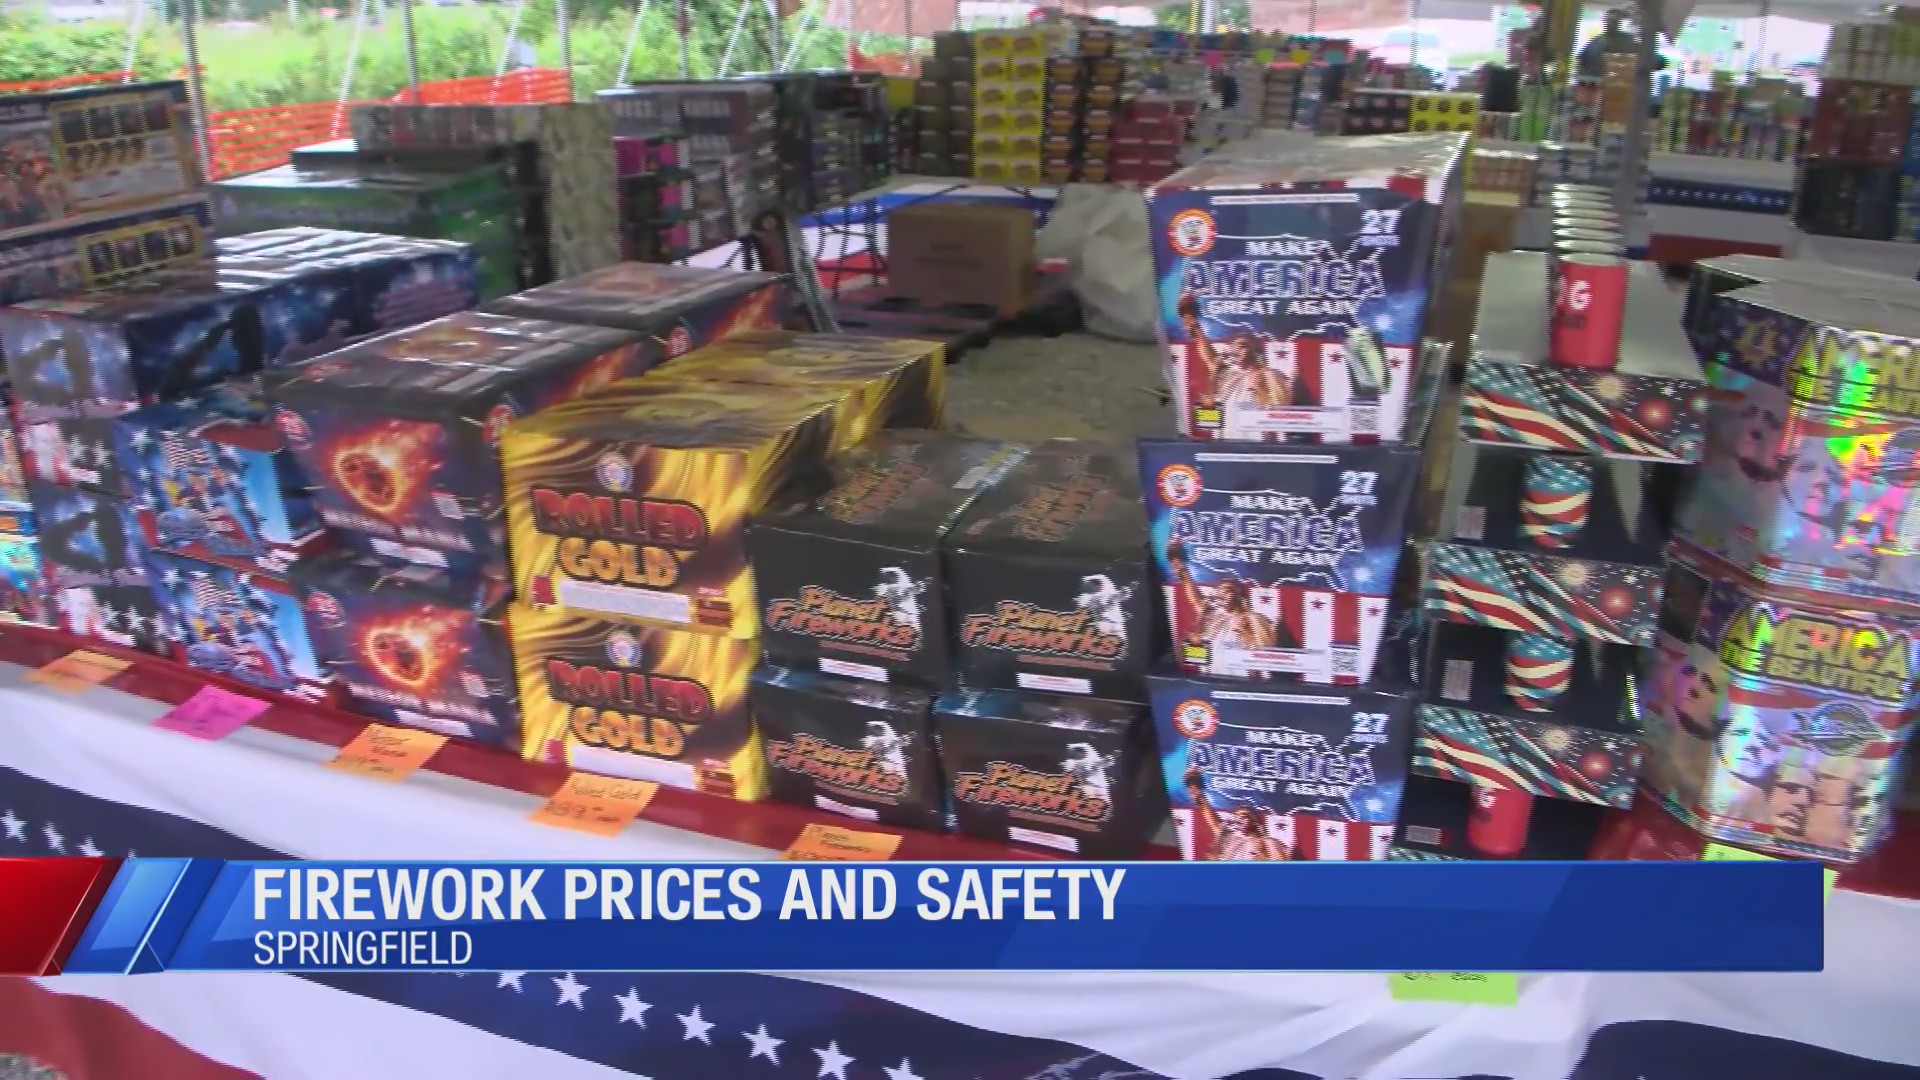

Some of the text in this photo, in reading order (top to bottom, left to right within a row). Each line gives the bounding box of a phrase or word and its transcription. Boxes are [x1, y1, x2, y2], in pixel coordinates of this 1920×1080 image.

[1360, 210, 1401, 233] 27
[1245, 241, 1318, 256] MAKE
[1182, 260, 1386, 299] AMERICA
[1204, 300, 1356, 316] GREAT AGAIN
[1339, 472, 1378, 493] 27
[531, 486, 709, 546] ROLLED
[1230, 495, 1302, 510] MAKE
[1169, 510, 1364, 550] AMERICA
[557, 537, 680, 588] GOLD
[1194, 550, 1339, 566] GREAT AGAIN
[801, 585, 888, 621] Planet
[998, 600, 1091, 632] Planet
[766, 599, 922, 650] Fireworks
[962, 613, 1128, 660] Fireworks
[1720, 601, 1914, 682] AMERICA
[545, 658, 714, 724] ROLLED
[571, 706, 686, 759] GOLD
[1246, 730, 1314, 747] MAKE
[1351, 712, 1390, 733] 27
[767, 739, 909, 796] Fireworks
[791, 733, 877, 768] Planet
[1186, 741, 1377, 786] AMERICA
[986, 761, 1074, 792] Planet
[1209, 777, 1350, 797] GREAT AGAIN
[955, 771, 1114, 822] Fireworks
